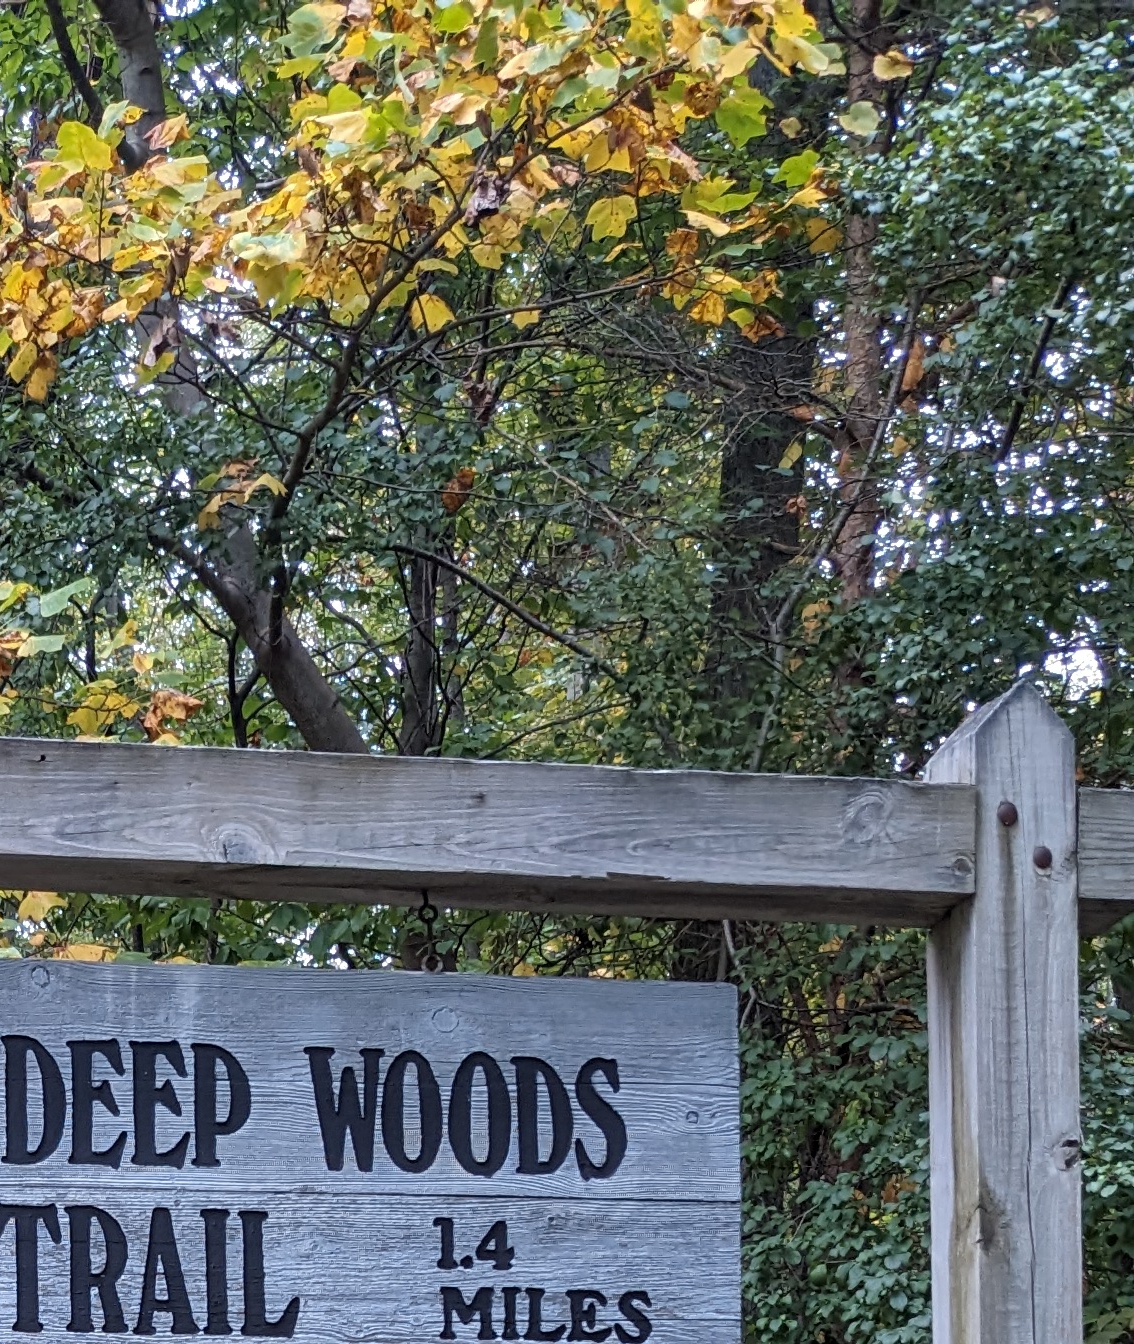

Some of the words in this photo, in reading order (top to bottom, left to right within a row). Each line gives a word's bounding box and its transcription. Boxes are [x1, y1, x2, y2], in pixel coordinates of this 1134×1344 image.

[0, 1034, 251, 1169] DEEP
[303, 1046, 627, 1181] WOODS
[432, 1216, 515, 1271] 1.4
[439, 1285, 653, 1344] MILES
